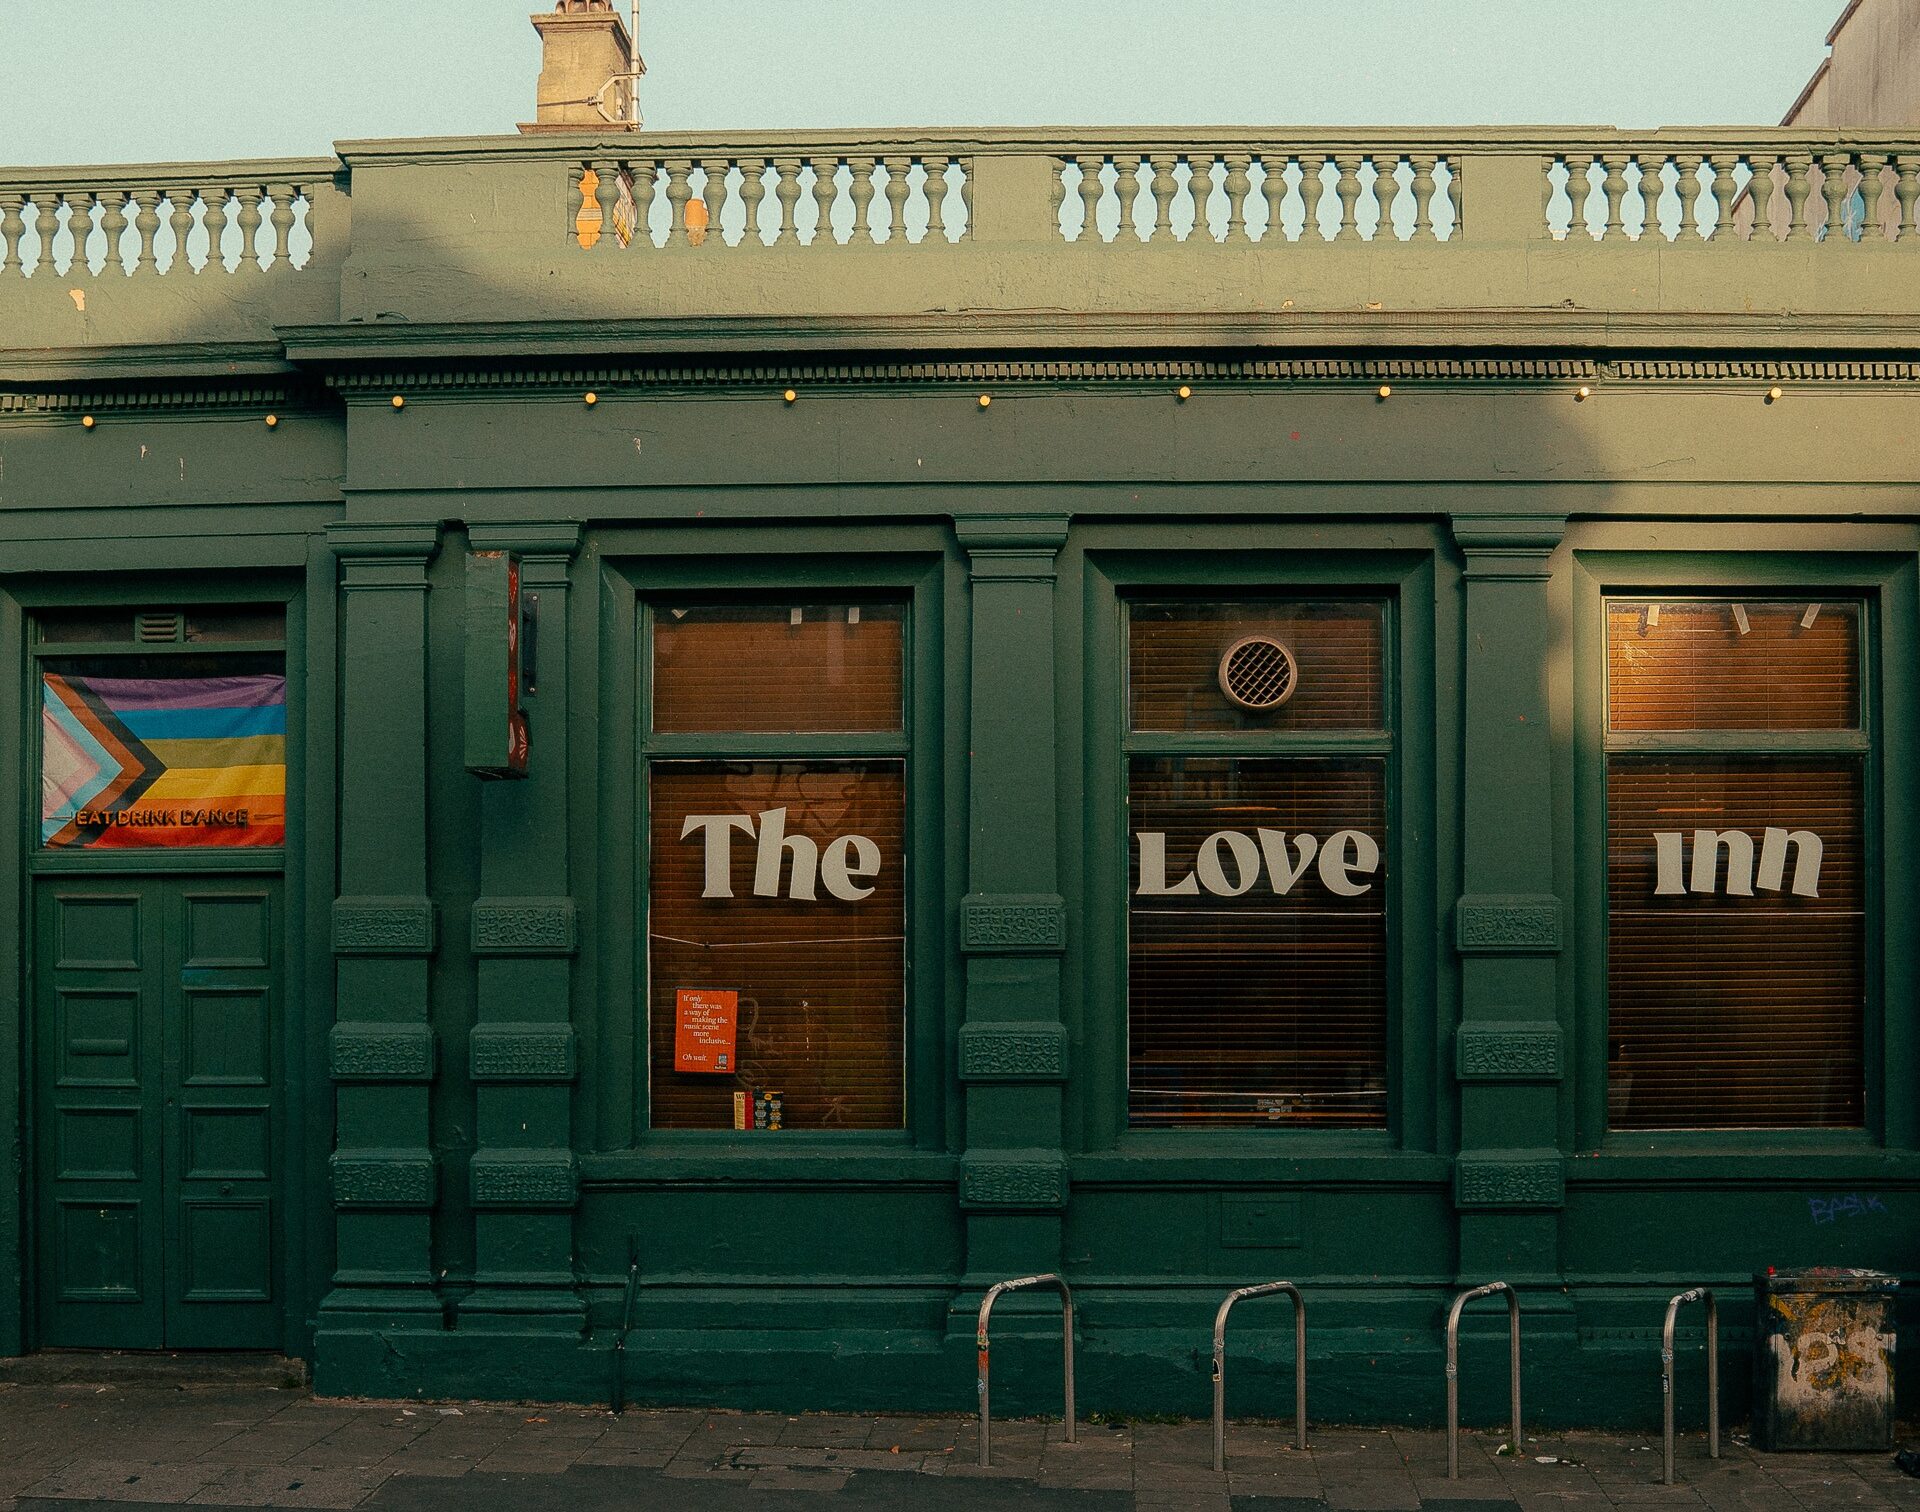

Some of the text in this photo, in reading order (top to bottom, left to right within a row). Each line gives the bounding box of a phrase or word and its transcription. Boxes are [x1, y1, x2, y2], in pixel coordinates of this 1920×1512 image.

[76, 808, 248, 826] EAT DRINK DANCE
[680, 806, 881, 901] The
[1135, 827, 1380, 896] Love
[683, 994, 702, 1003] If only
[692, 1016, 728, 1025] making the
[682, 1053, 693, 1061] Oh
